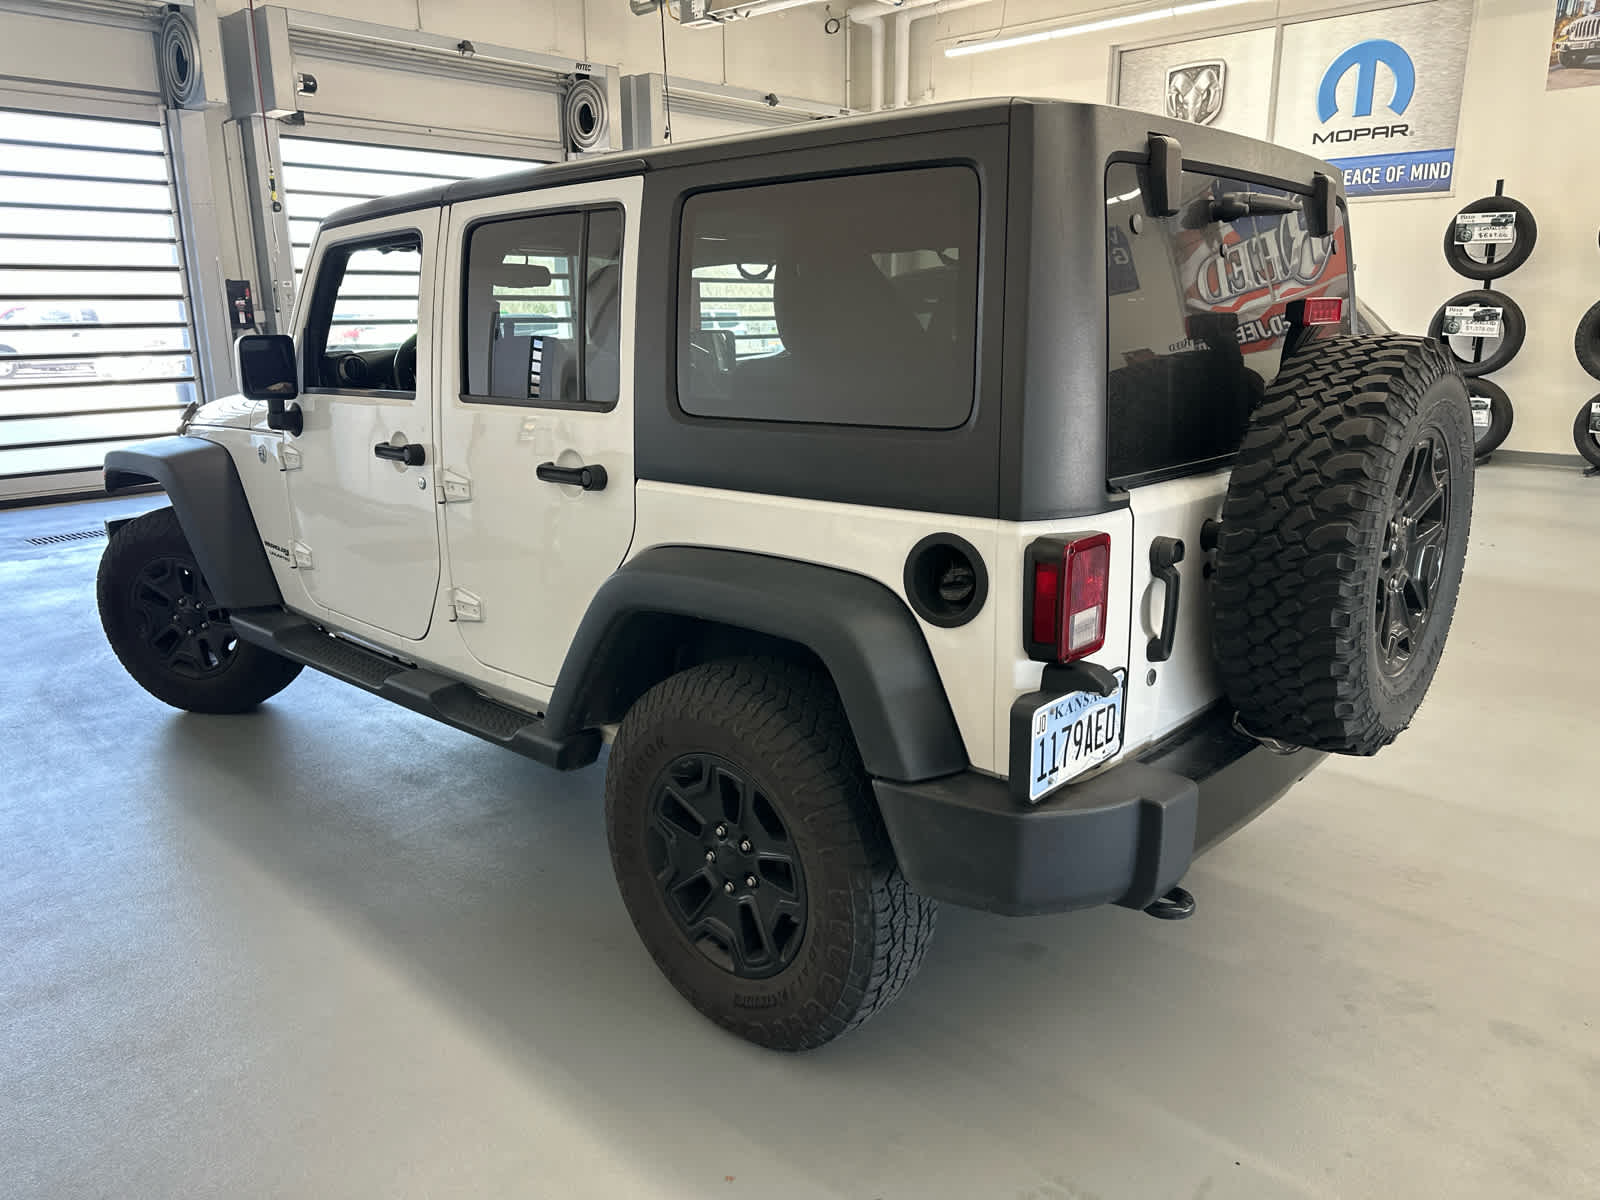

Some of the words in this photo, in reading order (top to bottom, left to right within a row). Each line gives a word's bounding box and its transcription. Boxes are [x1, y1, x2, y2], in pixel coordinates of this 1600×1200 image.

[1312, 124, 1409, 144] MOPAR
[1342, 167, 1381, 186] EACE
[1385, 165, 1406, 183] OF
[1410, 161, 1451, 181] MIND
[1054, 692, 1102, 720] KANSA
[1036, 703, 1117, 782] 1179AED
